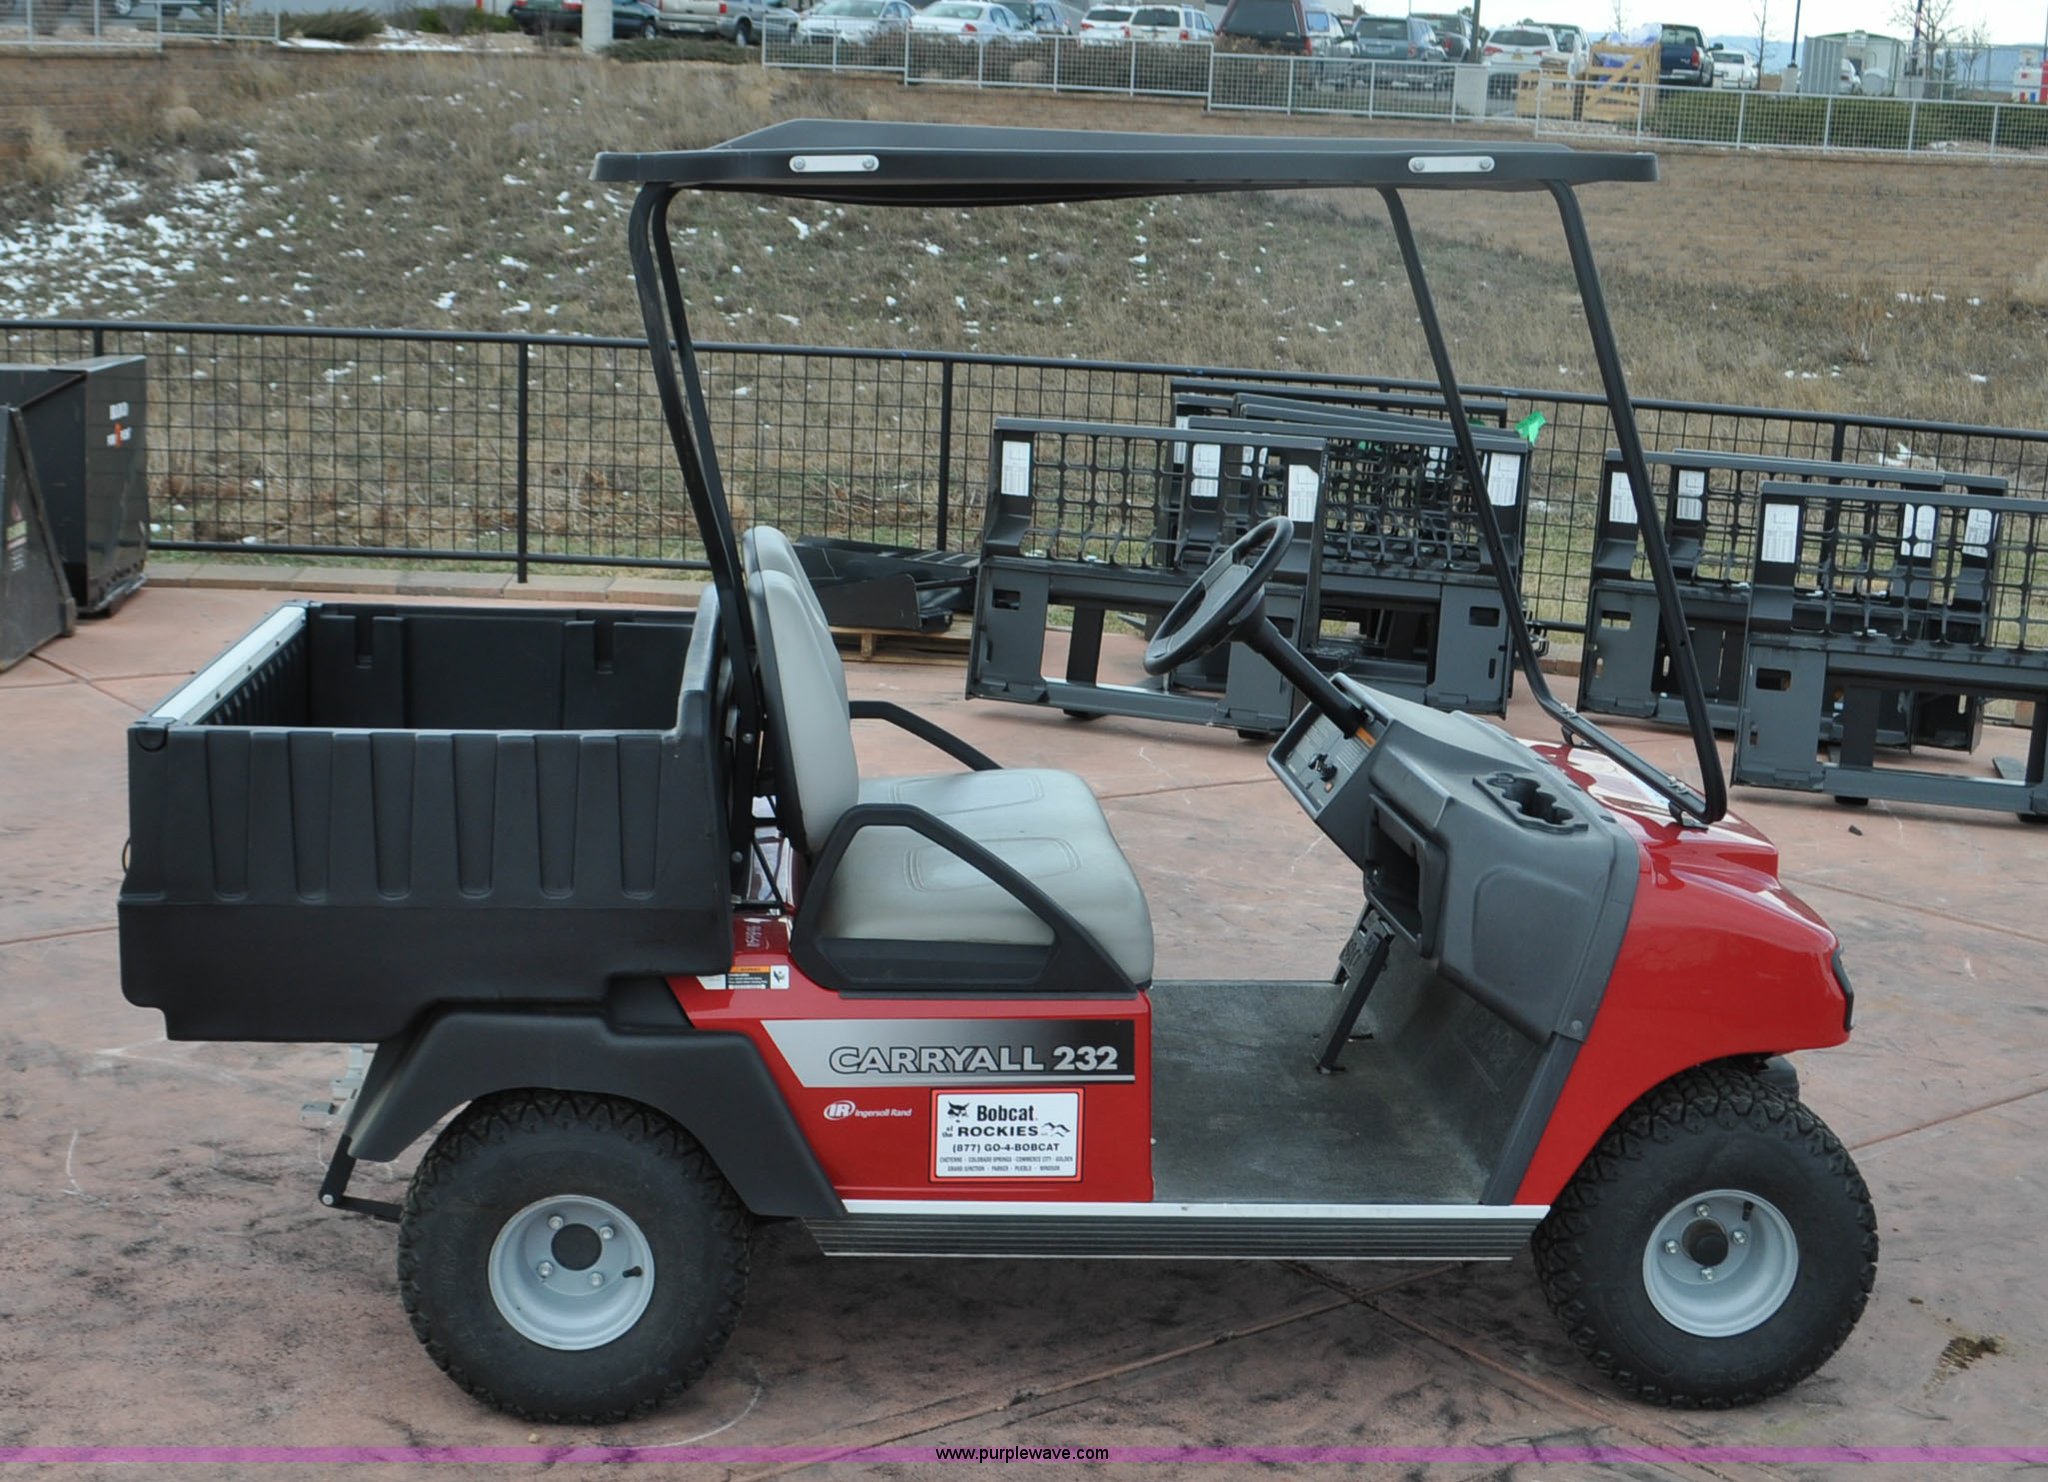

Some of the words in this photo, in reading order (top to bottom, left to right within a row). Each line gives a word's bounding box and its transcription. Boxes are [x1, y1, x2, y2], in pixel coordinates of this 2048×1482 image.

[830, 1046, 1045, 1074] CARRYALL
[1053, 1046, 1118, 1070] 232
[855, 1109, 889, 1118] Ingersoll
[891, 1108, 912, 1117] Rand
[976, 1105, 1034, 1122] Bobcat
[958, 1126, 1038, 1137] ROCKIES
[952, 1143, 981, 1153] (877)
[984, 1143, 1060, 1152] GO-4-BOBCAT
